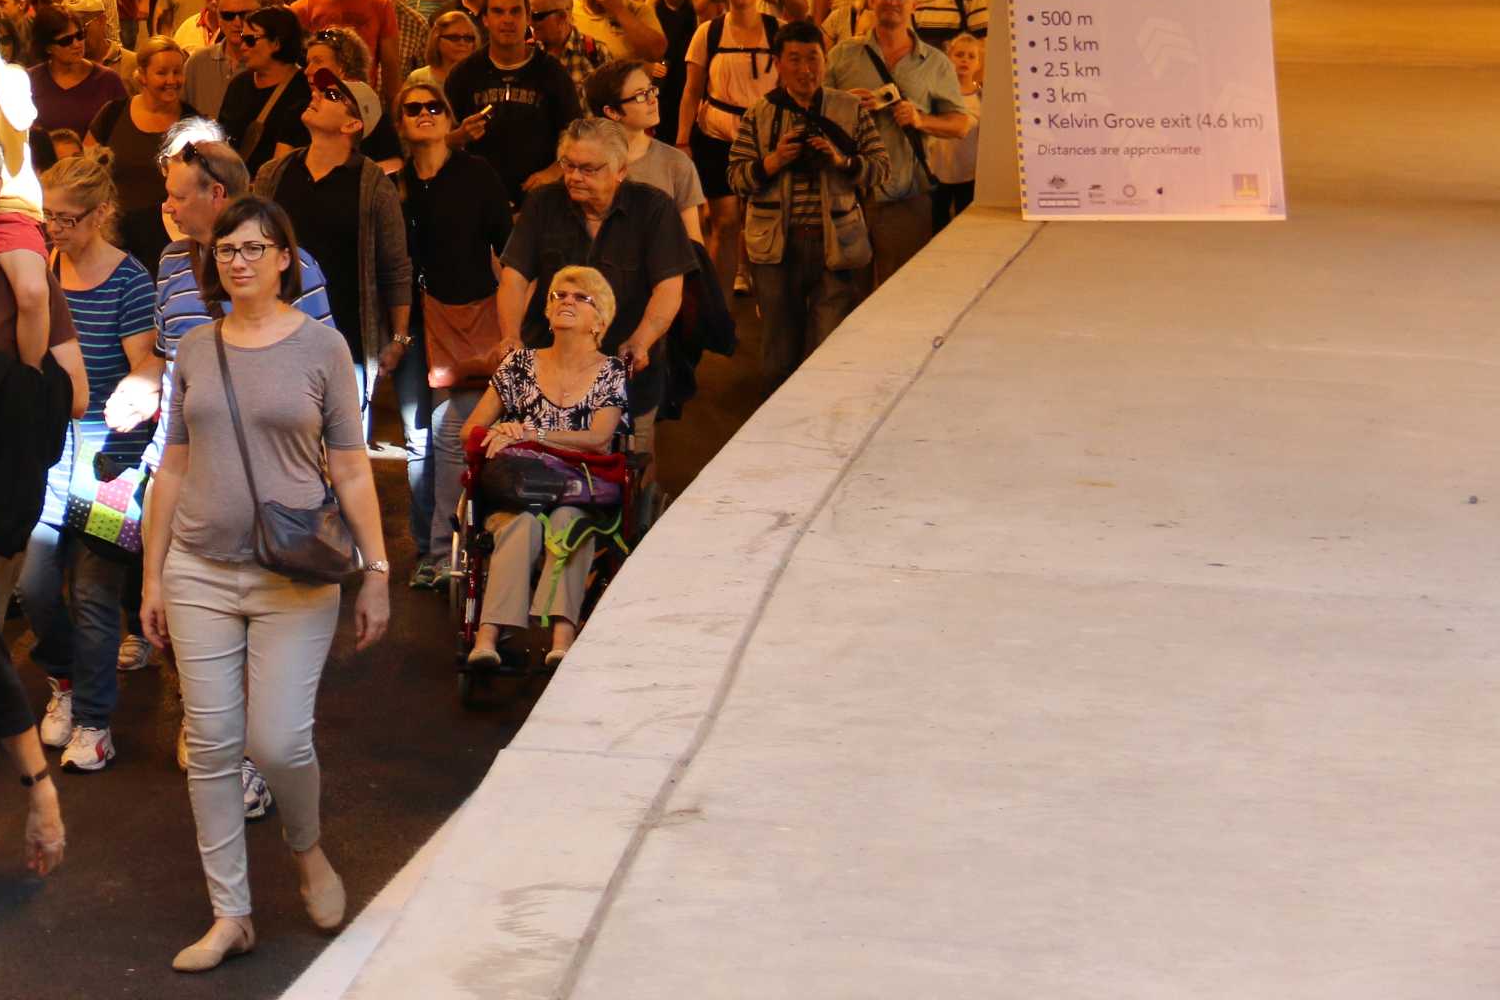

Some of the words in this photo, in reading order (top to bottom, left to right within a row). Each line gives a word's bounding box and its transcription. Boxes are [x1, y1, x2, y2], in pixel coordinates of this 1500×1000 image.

[1041, 11, 1072, 27] 500
[1077, 15, 1093, 27] m
[1043, 36, 1068, 52] 1.5
[1073, 36, 1099, 52] km
[1044, 62, 1070, 78] 2.5
[1075, 61, 1101, 78] km
[1046, 88, 1057, 103] 3
[1061, 86, 1087, 103] km
[1048, 113, 1099, 130] Kelvin
[1103, 113, 1156, 130] Grove
[1160, 113, 1192, 129] exit
[1196, 112, 1228, 131] (4.6
[1232, 111, 1265, 131] km)
[1037, 145, 1097, 156] Distances
[1101, 148, 1120, 156] are
[1123, 144, 1202, 158] approximate
